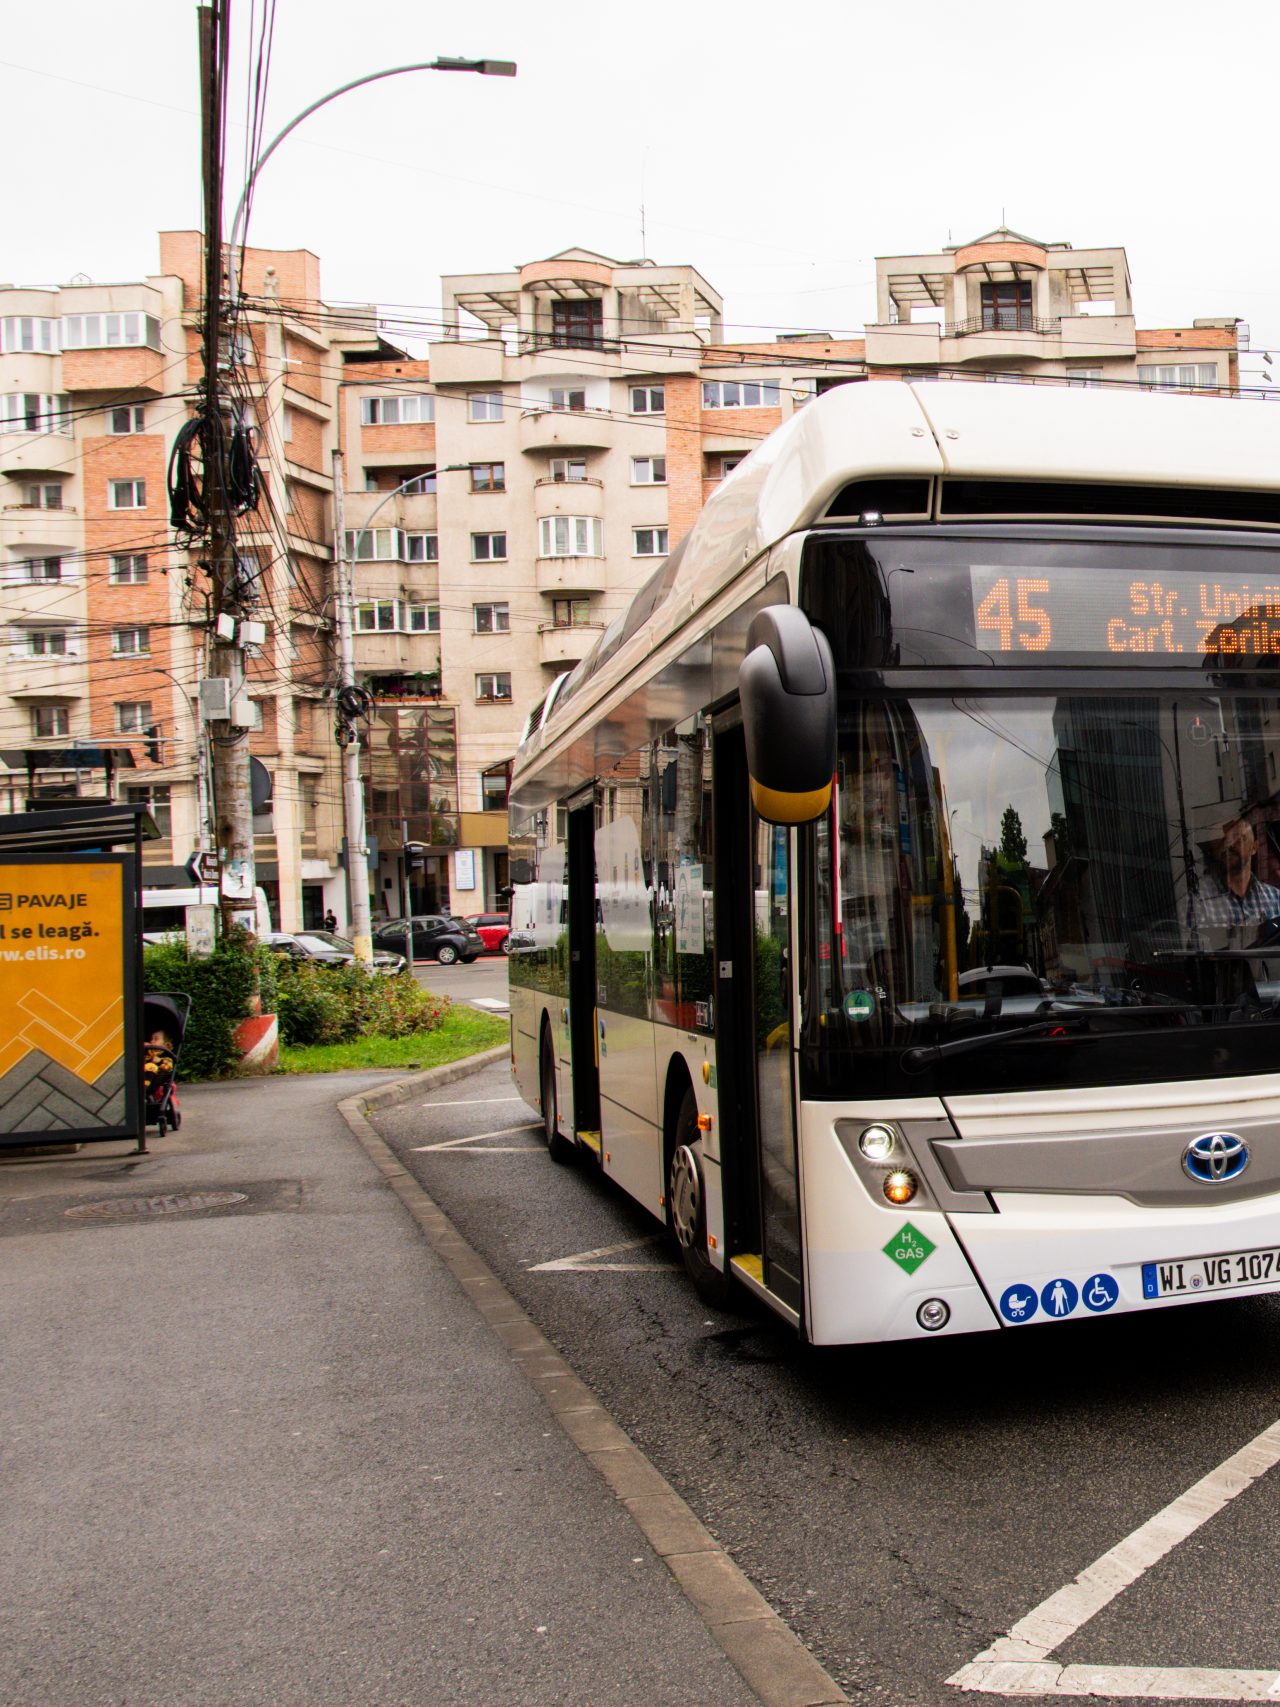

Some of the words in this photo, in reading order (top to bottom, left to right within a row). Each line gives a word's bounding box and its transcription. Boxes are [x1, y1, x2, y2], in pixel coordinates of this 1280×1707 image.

[977, 578, 1051, 651] 45
[1129, 582, 1188, 616] Str.
[1200, 584, 1280, 618] Unirii
[1107, 618, 1184, 652] Cart.
[16, 893, 88, 910] PAVAJE
[10, 927, 33, 939] se
[38, 921, 100, 941] leagă.
[895, 1247, 924, 1260] GAS
[1159, 1263, 1187, 1292] WI
[1203, 1258, 1232, 1286] VG
